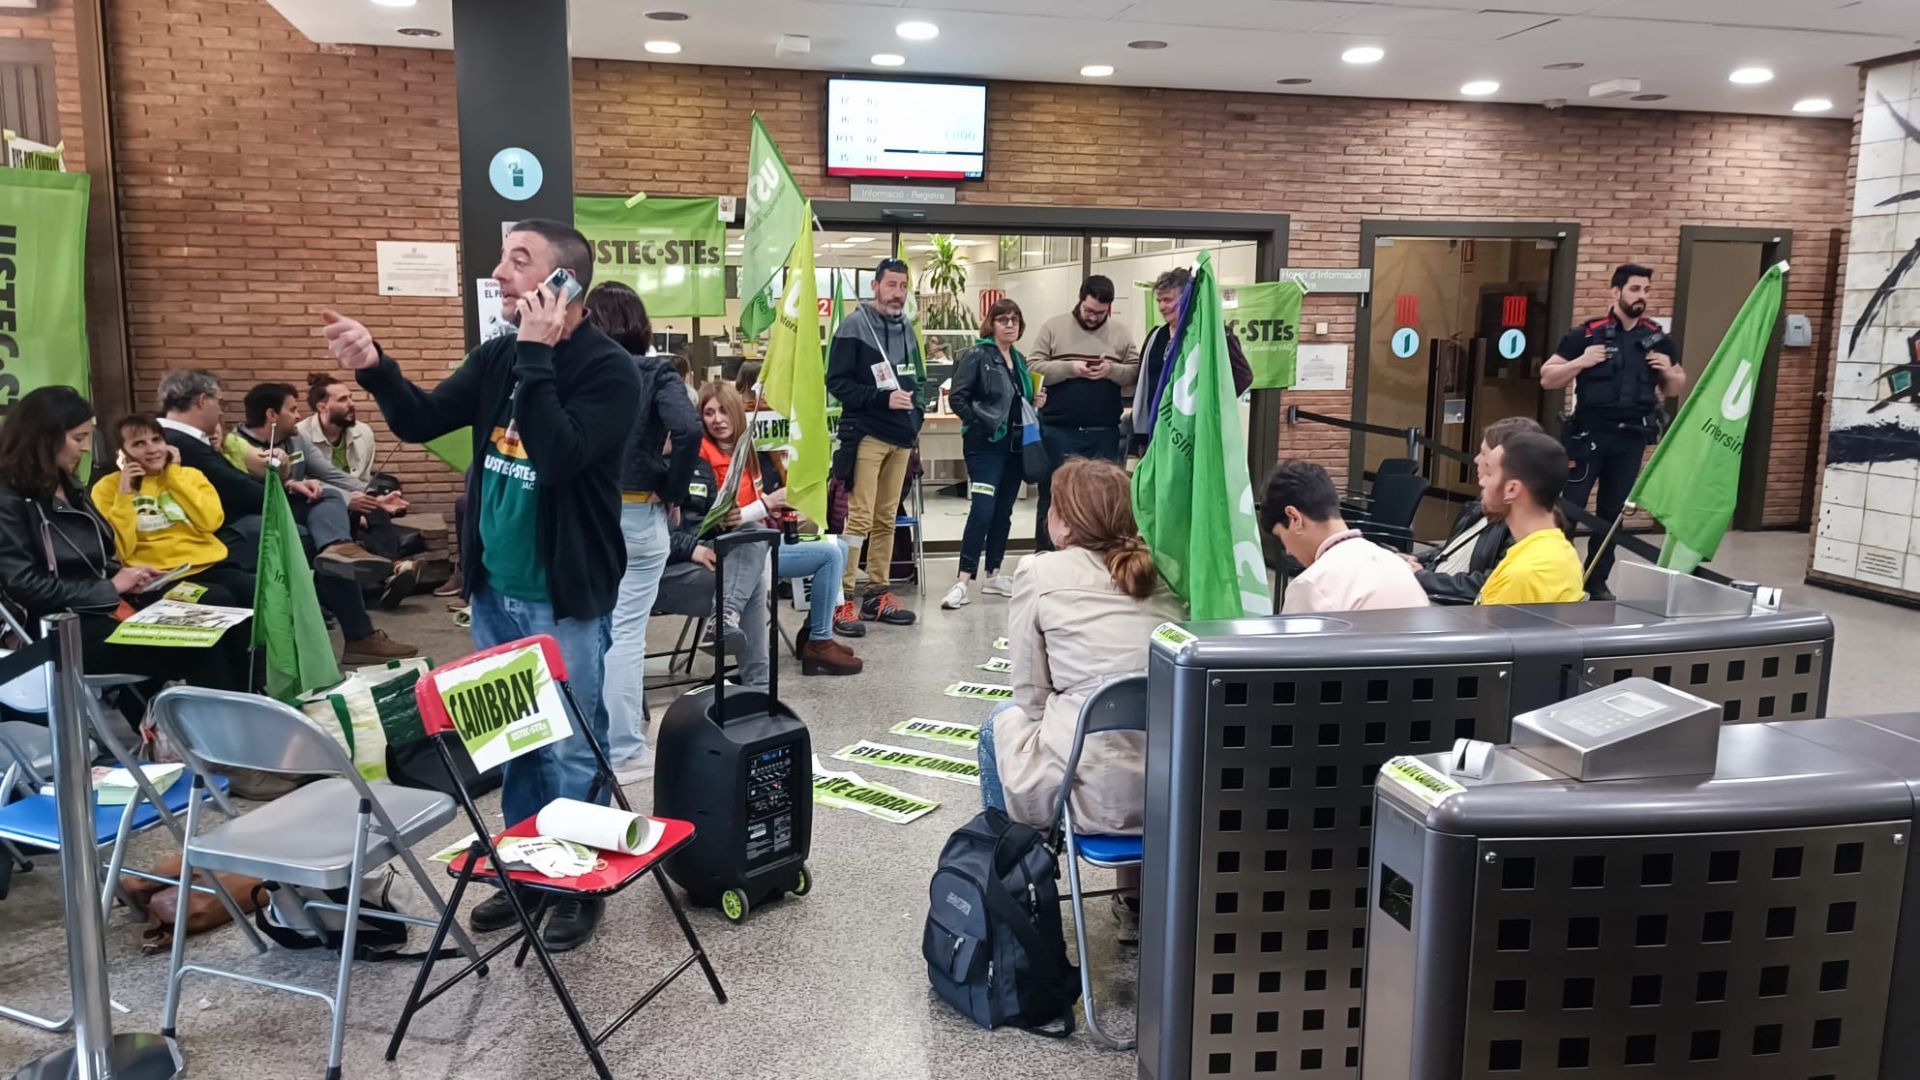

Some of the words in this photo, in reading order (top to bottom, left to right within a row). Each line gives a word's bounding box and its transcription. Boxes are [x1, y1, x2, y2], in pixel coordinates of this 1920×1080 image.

[818, 300, 829, 316] 2
[958, 685, 984, 696] BYE
[907, 722, 940, 733] BYE
[937, 727, 971, 739] BYE
[850, 746, 887, 759] BYE
[880, 752, 919, 765] BYE
[815, 777, 856, 794] BYE
[844, 788, 929, 815] CAMBRAY
